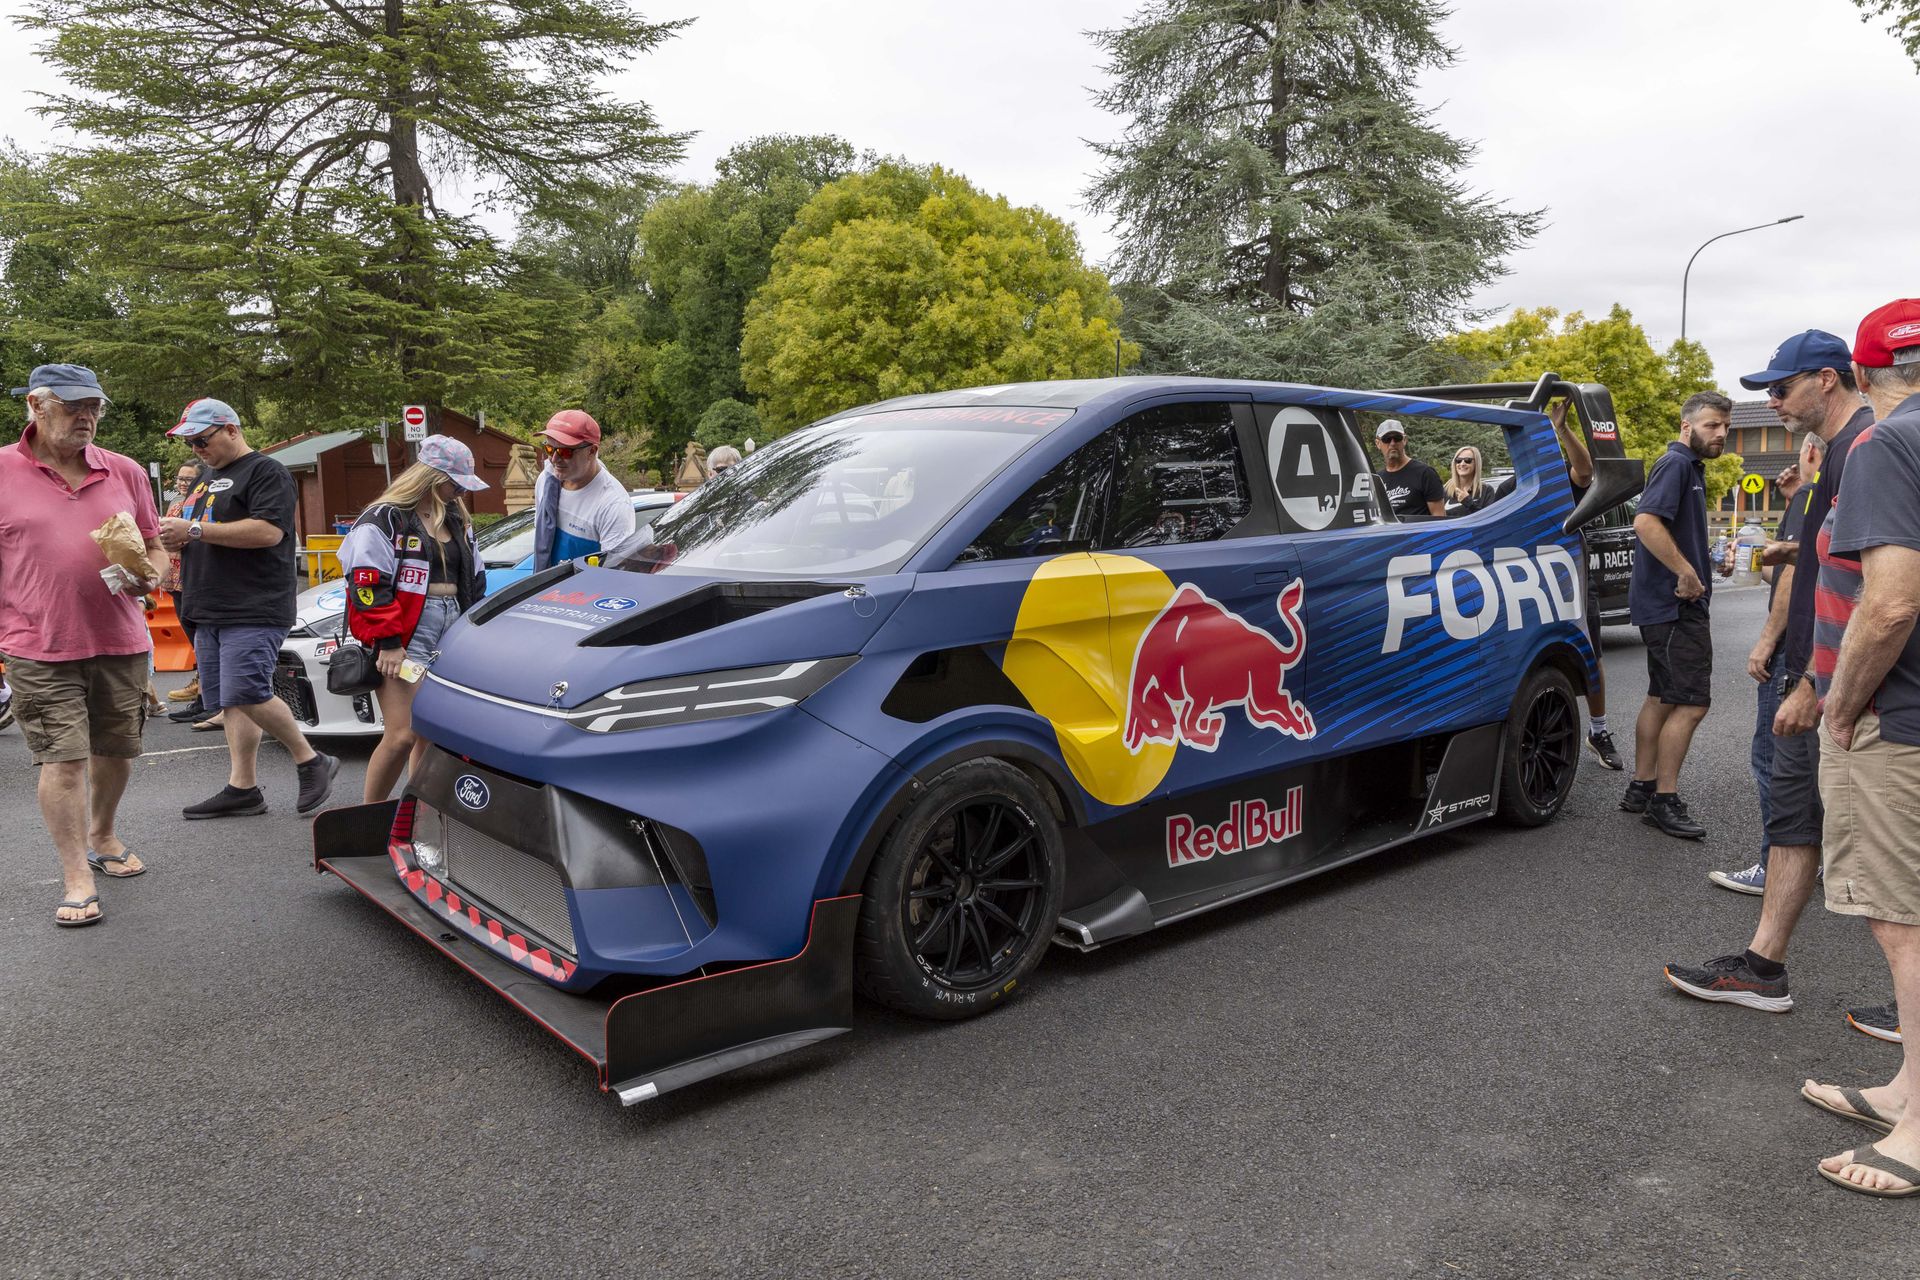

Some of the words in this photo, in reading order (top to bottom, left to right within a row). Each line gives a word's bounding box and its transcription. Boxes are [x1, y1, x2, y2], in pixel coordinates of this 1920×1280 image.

[1591, 420, 1615, 433] FORD
[1603, 550, 1628, 568] RACE
[359, 572, 373, 582] F-1
[1381, 544, 1582, 655] FORD
[460, 778, 483, 806] Ford
[1448, 794, 1491, 813] STARD
[1166, 800, 1242, 867] Red
[1244, 785, 1303, 850] Bull
